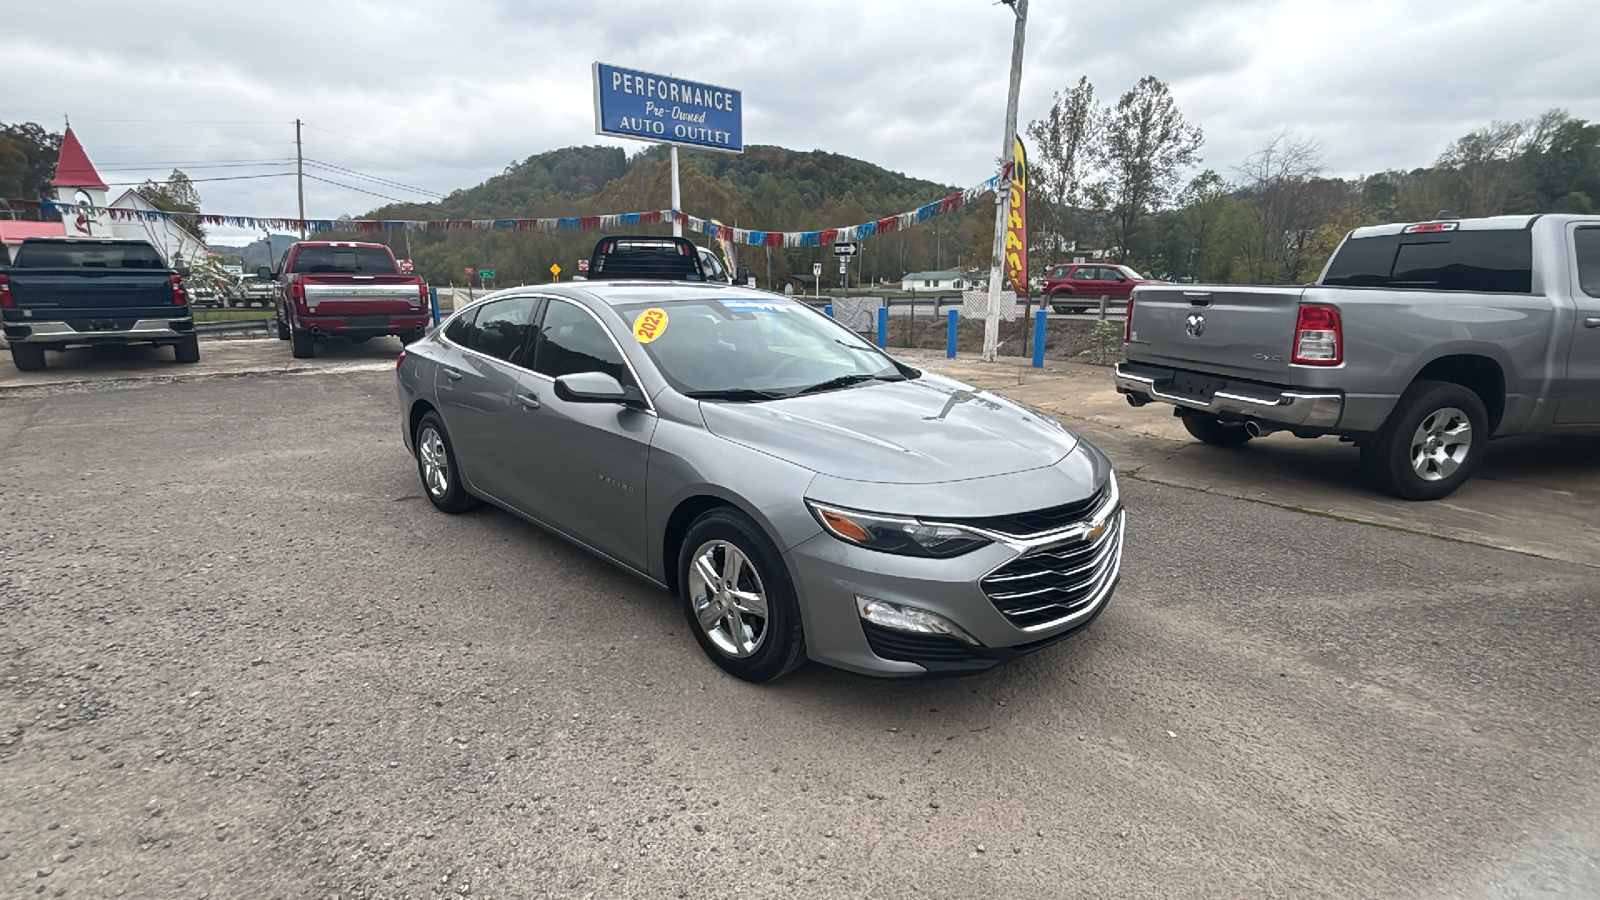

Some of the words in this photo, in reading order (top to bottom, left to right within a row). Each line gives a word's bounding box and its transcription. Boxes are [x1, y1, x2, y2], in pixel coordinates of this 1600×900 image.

[612, 71, 733, 111] PERFORMANCE
[645, 101, 707, 124] Pre-Owned
[619, 116, 665, 135] AUTO
[674, 124, 731, 144] OUTLET
[638, 310, 664, 339] 2023
